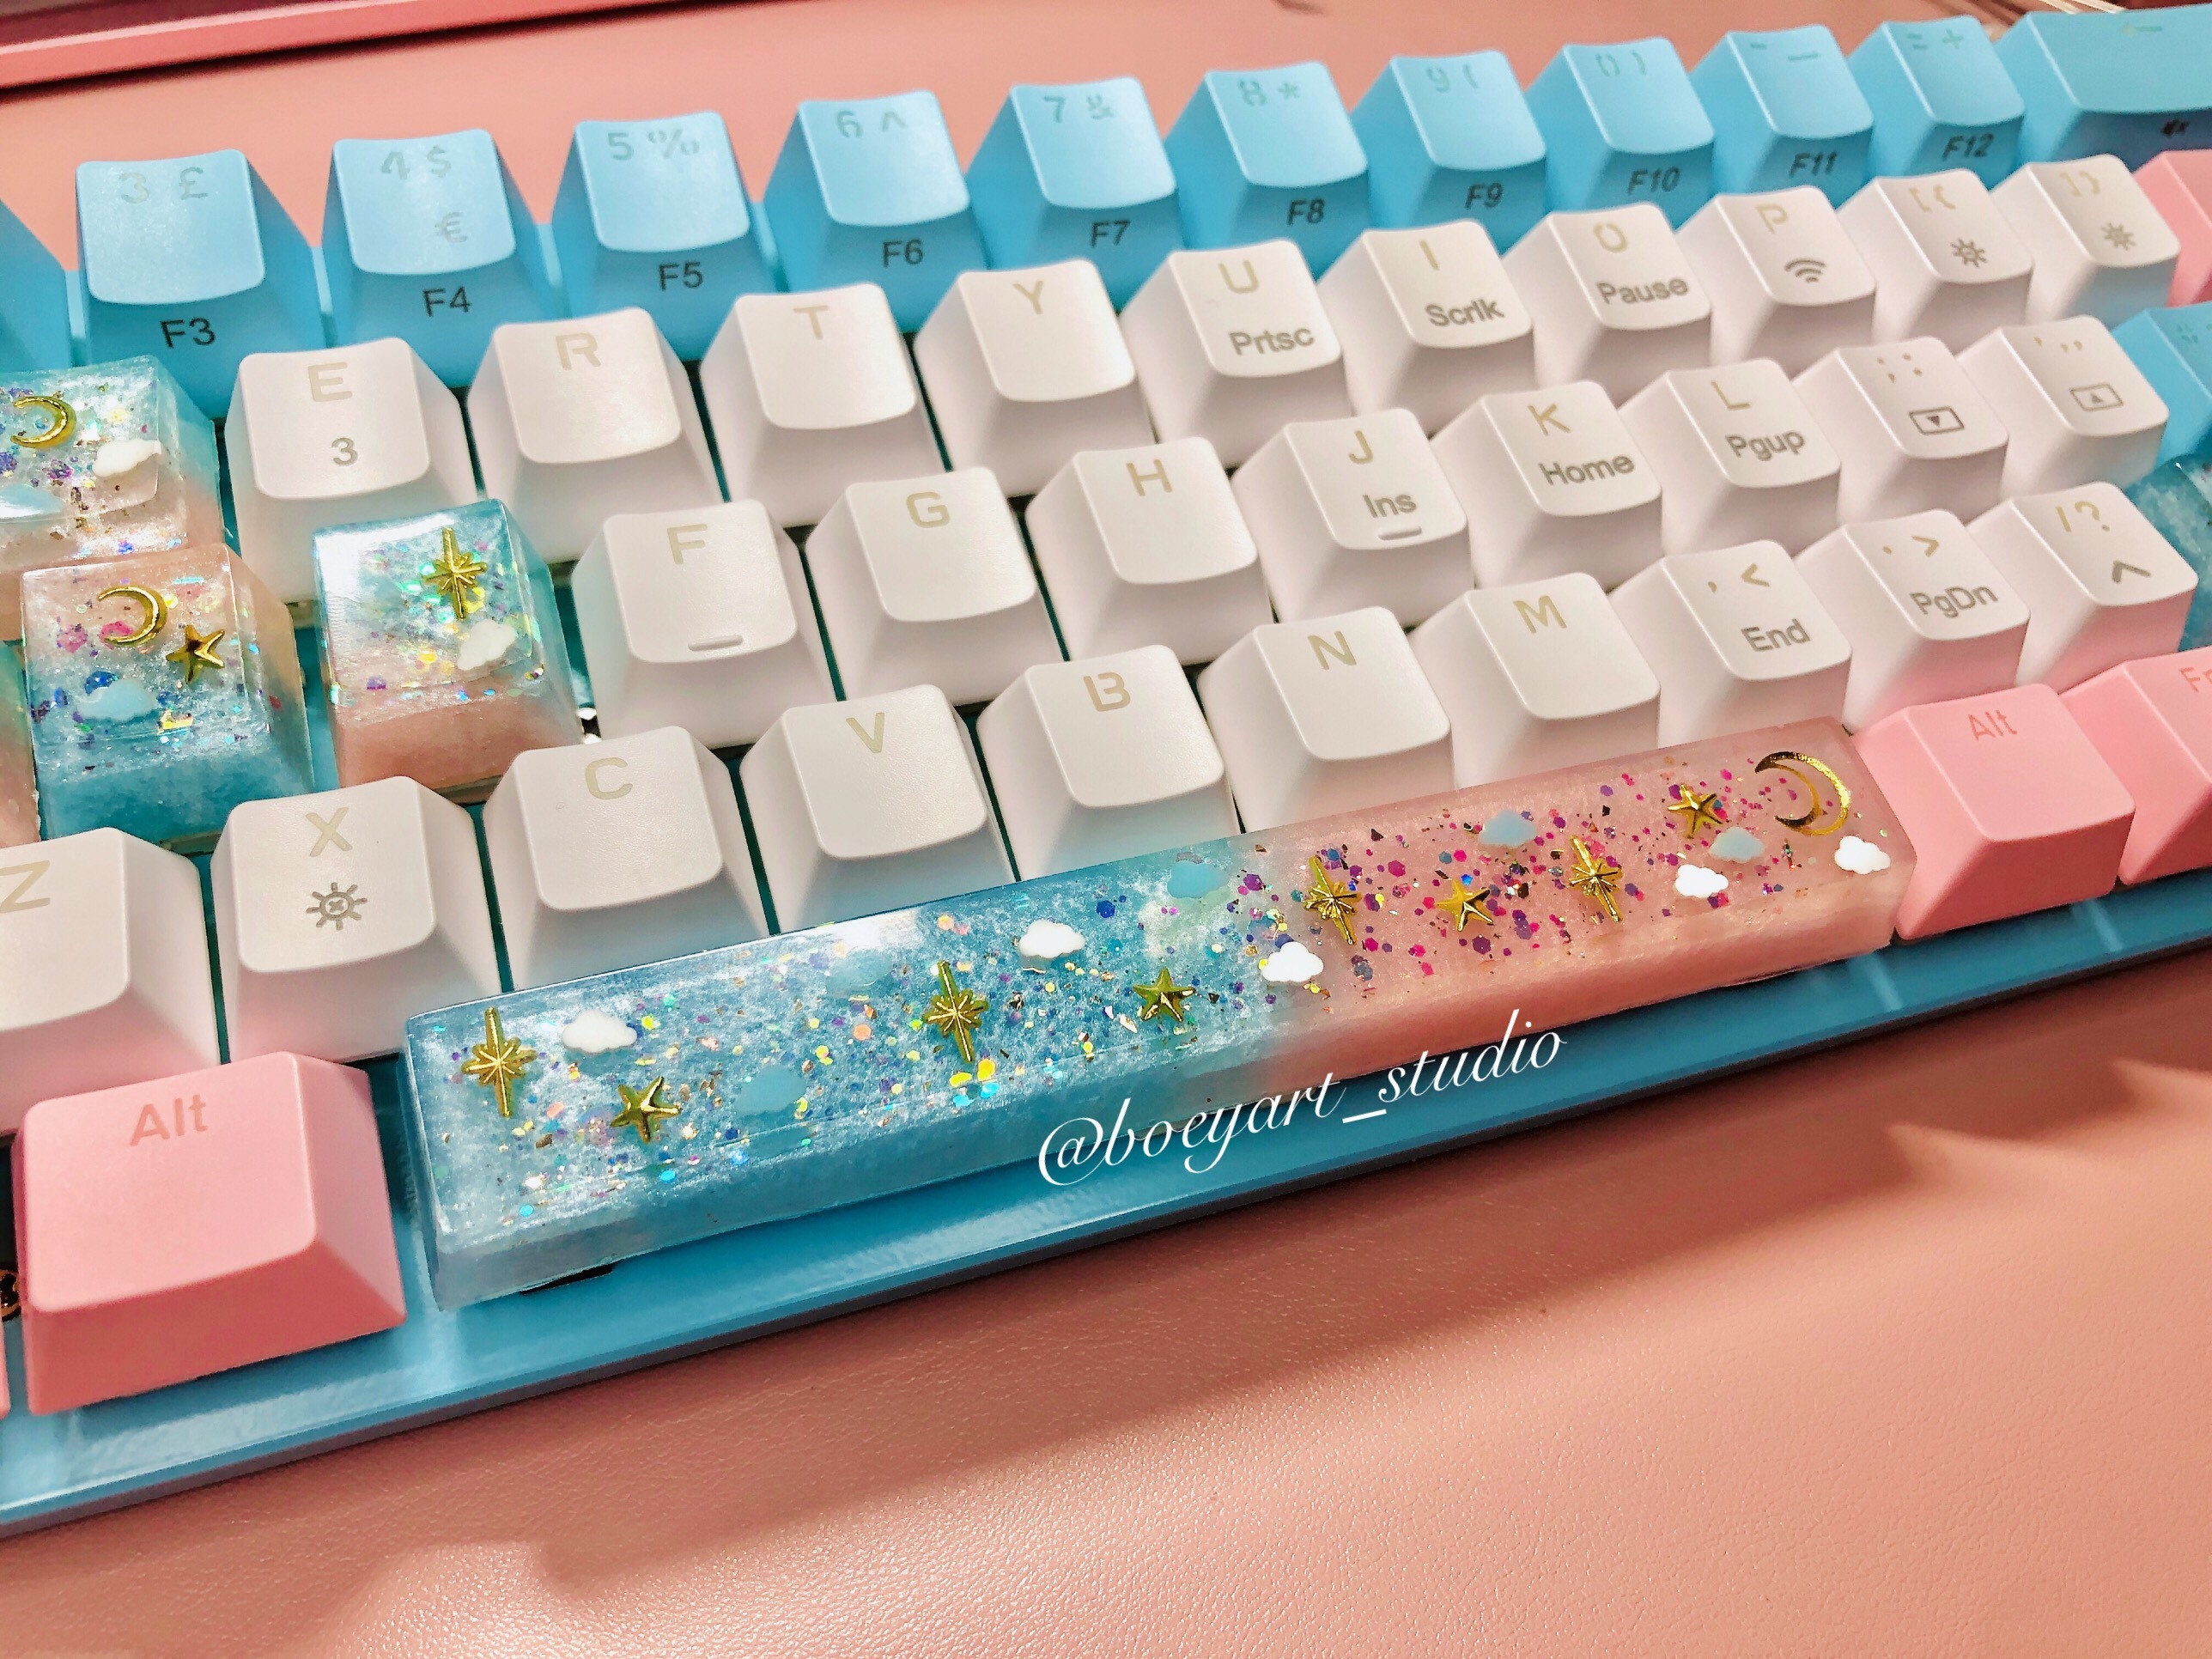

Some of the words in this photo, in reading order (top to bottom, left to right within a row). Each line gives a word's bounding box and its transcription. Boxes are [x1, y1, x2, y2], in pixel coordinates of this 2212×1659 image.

[1942, 29, 1964, 49] +
[1238, 78, 1266, 105] 8
[1427, 67, 1449, 92] 9
[836, 111, 861, 137] 6
[1044, 97, 1066, 123] 7
[608, 132, 632, 160] 5
[647, 128, 698, 158] %
[1942, 134, 1995, 158] F12
[428, 146, 452, 178] $
[1790, 151, 1838, 175] F11
[119, 172, 148, 204] 3
[179, 167, 209, 200] £
[1466, 183, 1504, 209] F9
[1628, 168, 1680, 194] F10
[1288, 198, 1326, 225] F8
[1755, 204, 1788, 234] P
[434, 212, 468, 243] €
[1091, 220, 1130, 246] F7
[1593, 223, 1627, 252] O
[882, 240, 924, 267] F6
[1419, 240, 1439, 270] I
[659, 262, 703, 289] F5
[1218, 260, 1260, 294] U
[423, 287, 471, 317] F4
[1013, 280, 1044, 314] Y
[1598, 277, 1688, 307] Pause
[793, 306, 829, 341] T
[1425, 299, 1504, 327] Scrlk
[161, 317, 216, 347] F3
[1230, 327, 1315, 356] Prtsc
[555, 331, 601, 370] R
[307, 362, 352, 402] E
[1712, 380, 1750, 410] L
[1528, 403, 1571, 435] K
[331, 437, 358, 466] 3
[1349, 430, 1374, 464] J
[1725, 431, 1804, 461] Pgup
[1127, 459, 1171, 496] H
[1540, 453, 1633, 487] Home
[906, 491, 950, 527] G
[1363, 490, 1418, 519] Ins
[666, 523, 708, 564] F
[1911, 534, 1940, 556] >
[1741, 563, 1770, 586] <
[1513, 596, 1566, 633] M
[1910, 584, 1998, 619] PgDn
[1308, 631, 1356, 670] N
[1741, 619, 1810, 653] End
[1083, 672, 1131, 711] B
[845, 712, 885, 753] V
[1969, 709, 2016, 741] Alt
[585, 757, 633, 799] C
[305, 807, 353, 857] X
[0, 860, 51, 913] Z
[129, 1094, 207, 1147] Alt
